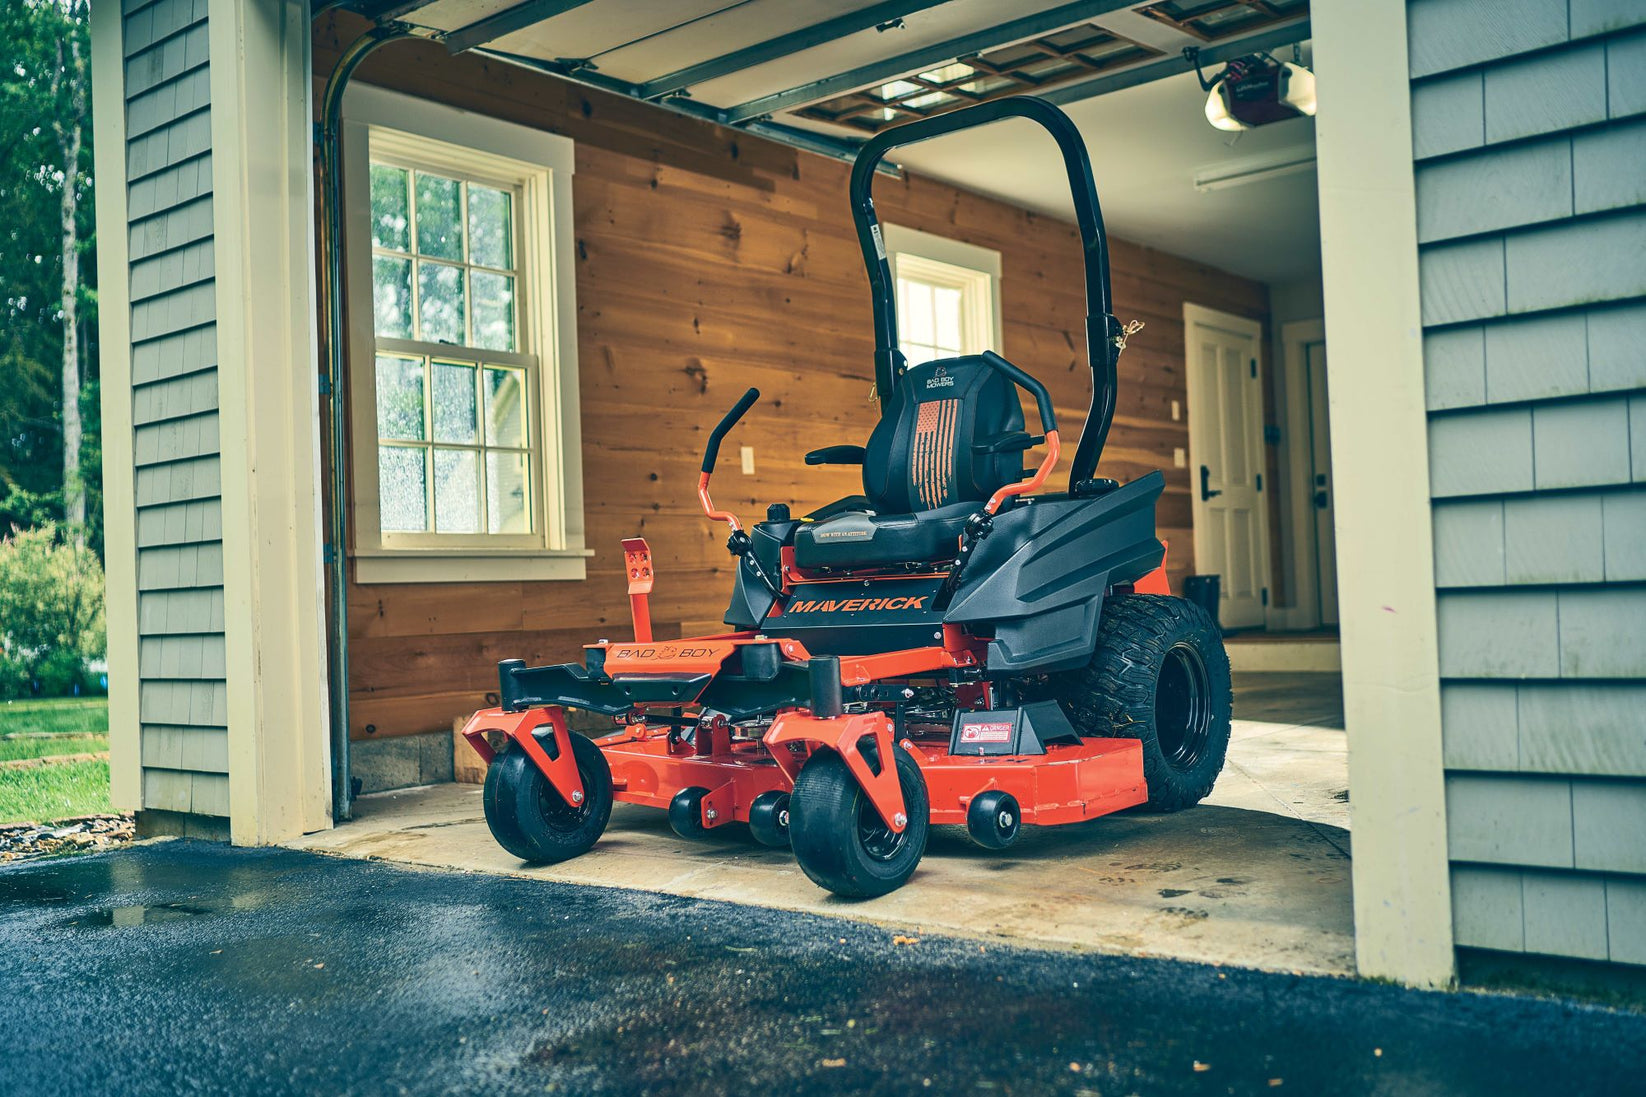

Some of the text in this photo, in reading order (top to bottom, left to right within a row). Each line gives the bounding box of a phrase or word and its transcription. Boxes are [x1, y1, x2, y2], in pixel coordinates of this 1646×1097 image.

[926, 380, 954, 389] MOWERS
[788, 596, 929, 613] MAVERICK
[617, 648, 720, 658] BAD BOY
